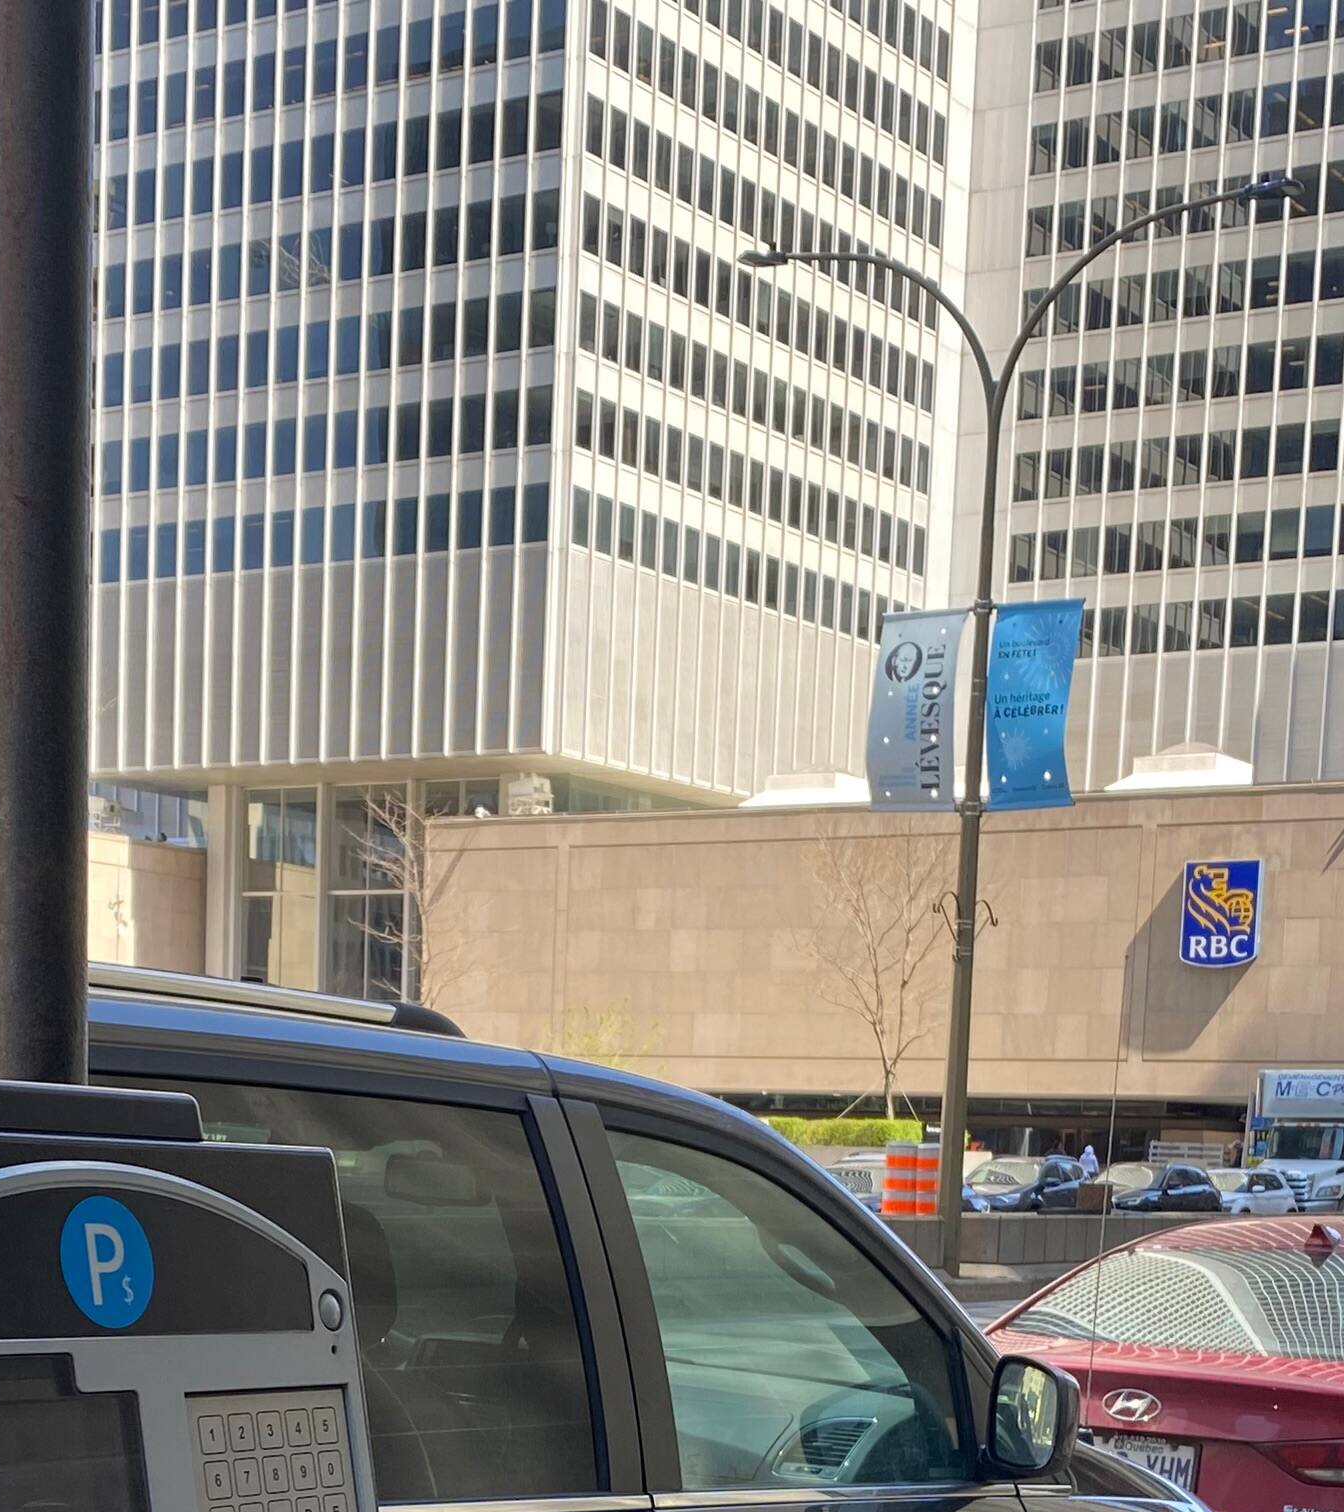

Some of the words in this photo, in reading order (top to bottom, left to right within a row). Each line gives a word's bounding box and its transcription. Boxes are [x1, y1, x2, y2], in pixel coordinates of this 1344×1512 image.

[994, 693, 1008, 704] Un
[1010, 691, 1051, 703] héritage
[904, 683, 920, 741] ANNÉE
[915, 644, 946, 790] LÉVESQUE
[1188, 934, 1249, 959] RBC
[239, 1426, 245, 1439] 2
[267, 1424, 273, 1436] 3
[296, 1422, 301, 1434] 4
[323, 1420, 328, 1432] 5
[215, 1474, 221, 1487] 6
[244, 1471, 249, 1483] 7
[273, 1468, 279, 1481] 8
[300, 1465, 307, 1478] 9
[328, 1463, 334, 1475] 0
